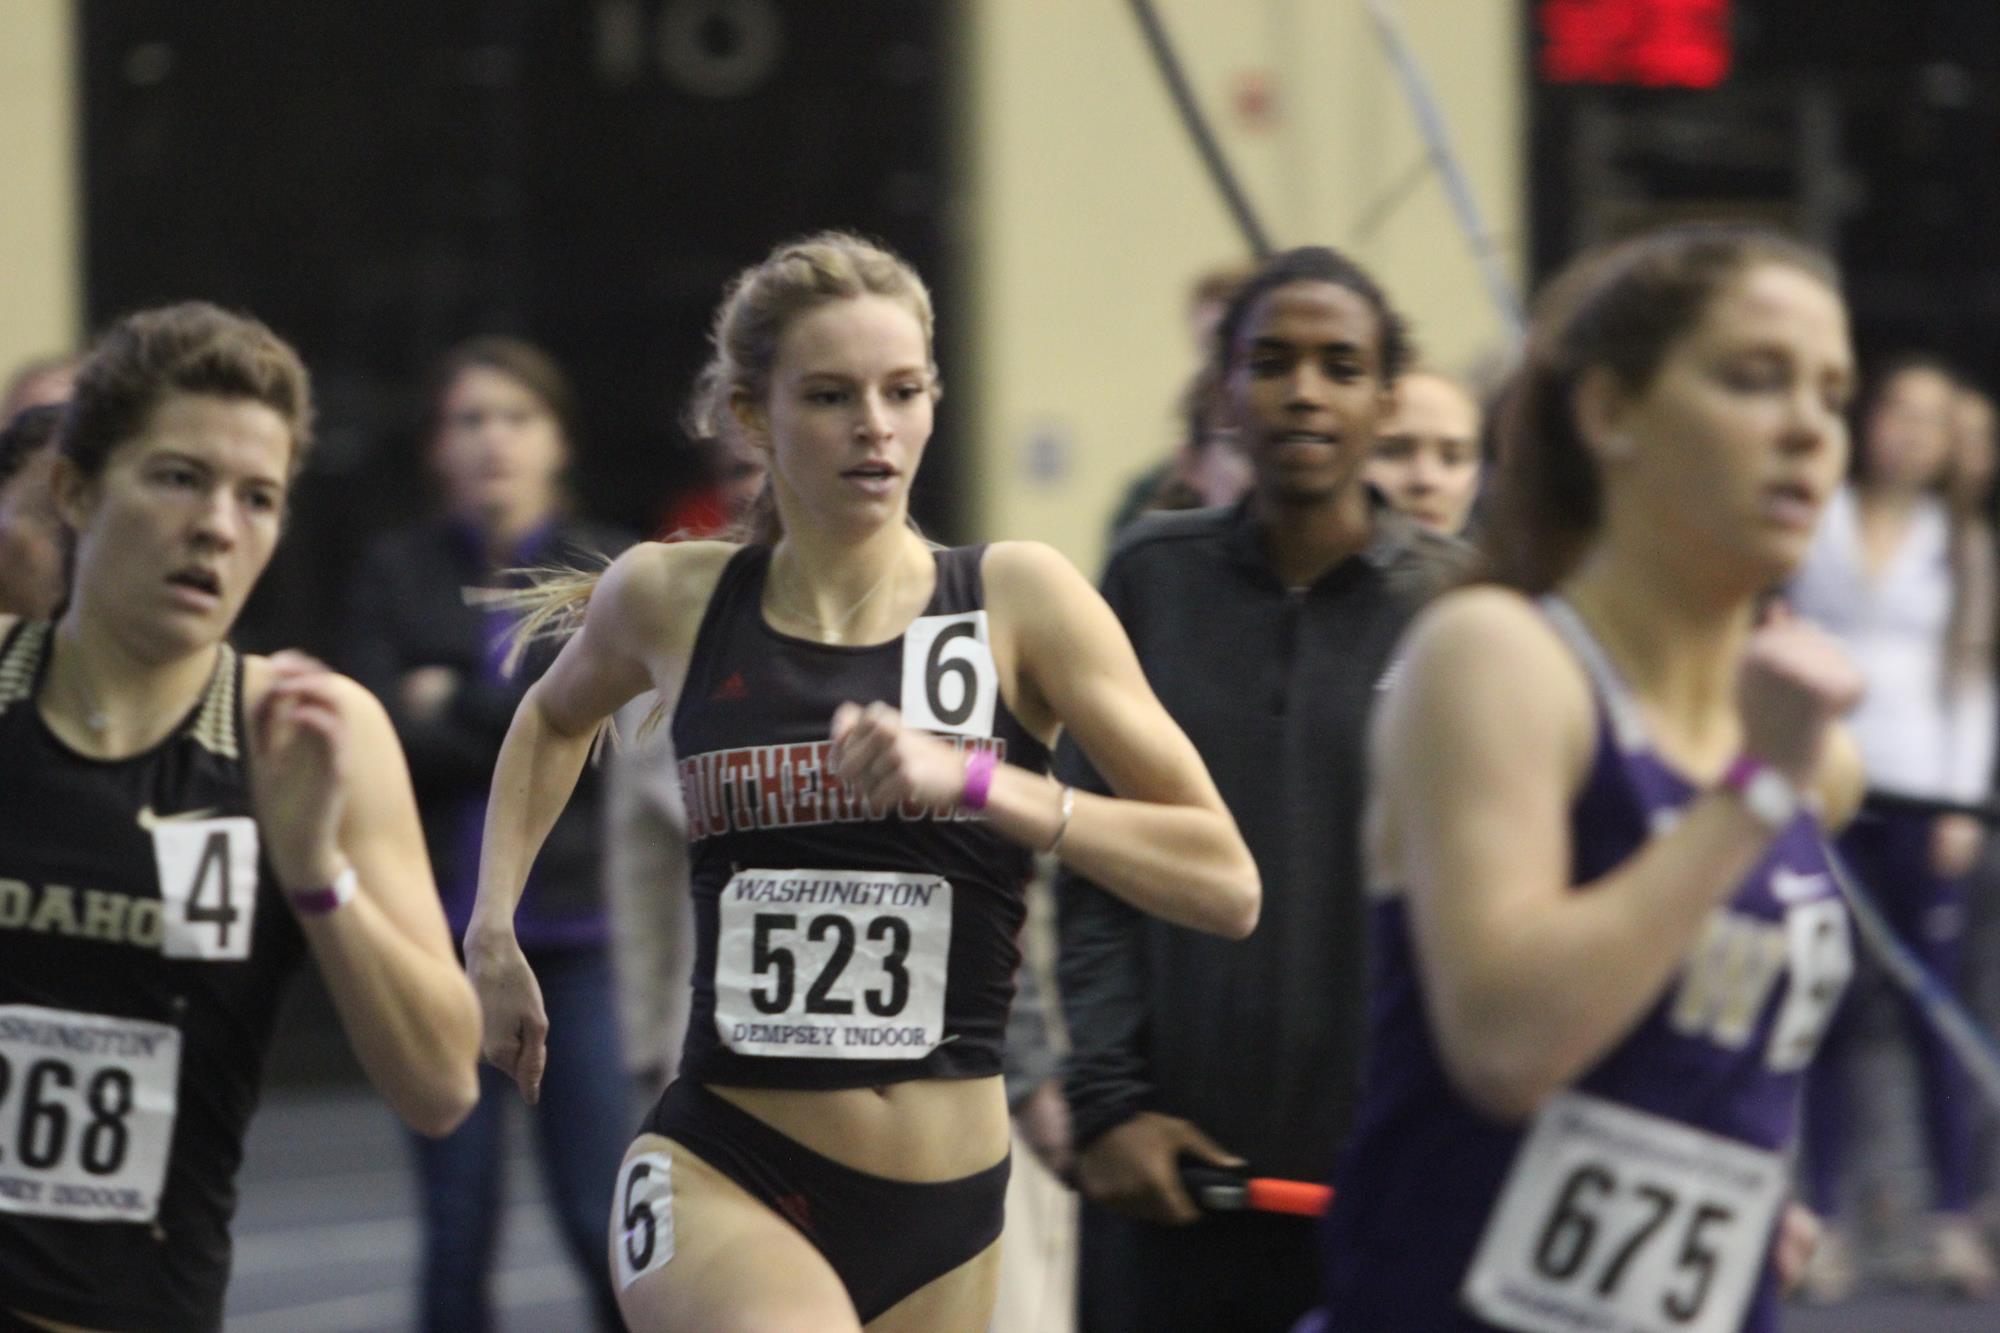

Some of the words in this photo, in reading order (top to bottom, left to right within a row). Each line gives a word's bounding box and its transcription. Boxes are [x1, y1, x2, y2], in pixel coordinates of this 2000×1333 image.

[925, 621, 977, 726] 6
[0, 877, 165, 948] DAHO
[185, 832, 238, 948] 4
[734, 878, 938, 906] WASHINGTON
[751, 913, 911, 1017] 523
[732, 1023, 836, 1046] DEMPSEY
[844, 1026, 928, 1046] INDOOR
[624, 1163, 656, 1271] 6
[1533, 1163, 1736, 1324] 675
